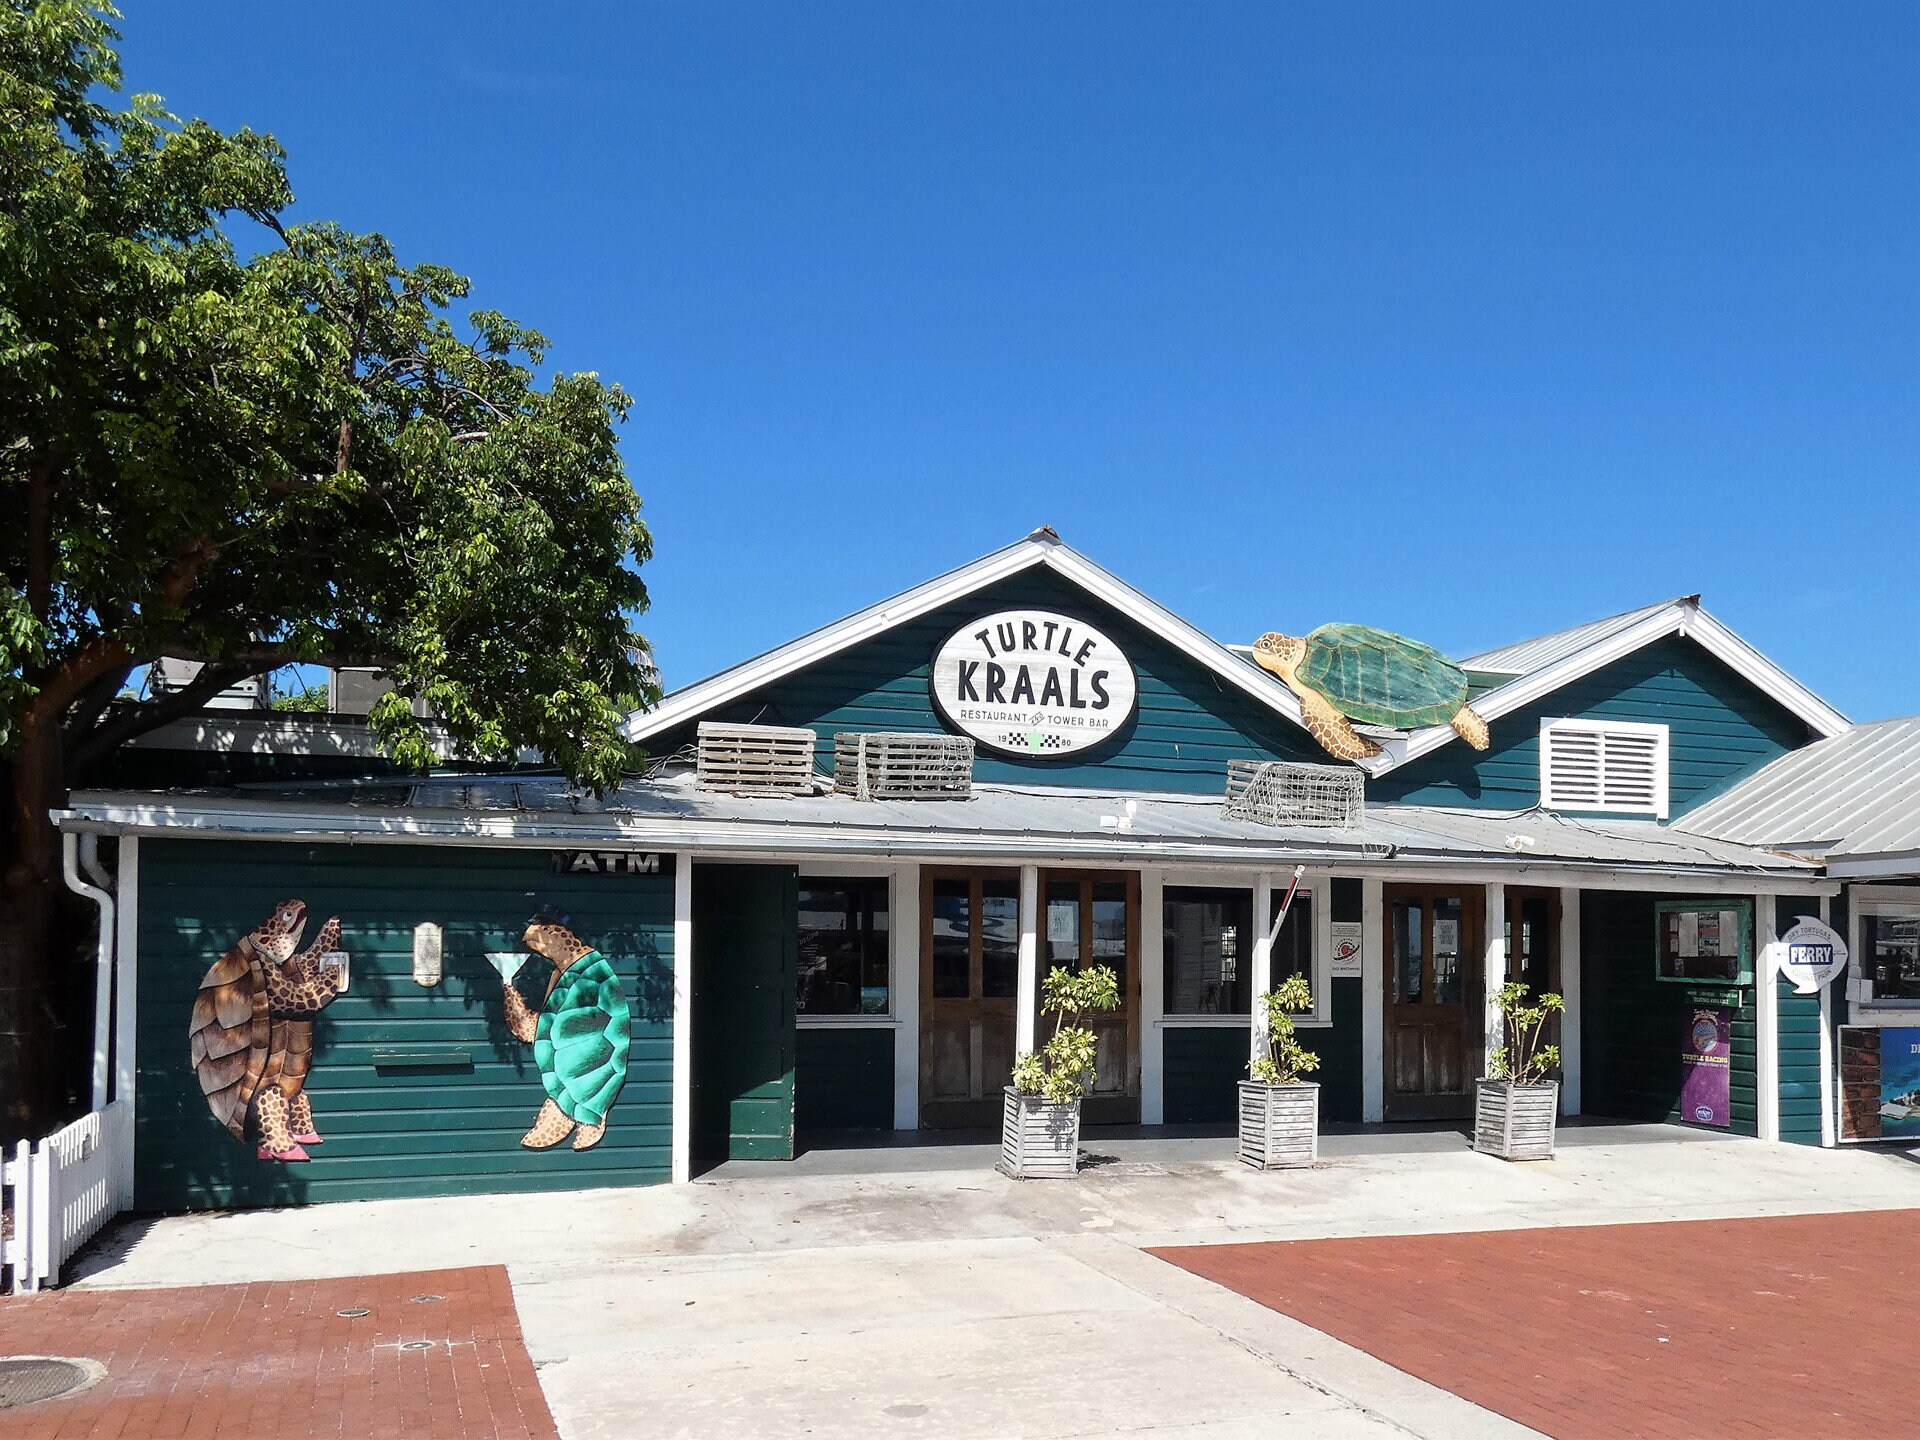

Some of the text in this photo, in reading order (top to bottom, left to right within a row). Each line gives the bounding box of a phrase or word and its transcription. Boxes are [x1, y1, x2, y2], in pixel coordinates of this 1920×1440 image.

[974, 620, 1097, 668] TURTLE
[958, 659, 1110, 710] KRAALS
[960, 709, 1028, 723] RESTAURANT
[1047, 715, 1084, 727] TOWER
[1089, 718, 1109, 728] BAR
[998, 735, 1007, 743] 19
[570, 852, 660, 873] ATM
[1800, 926, 1832, 941] TORTUGAS
[1790, 946, 1832, 963] FERRY
[1704, 1055, 1728, 1064] RACING
